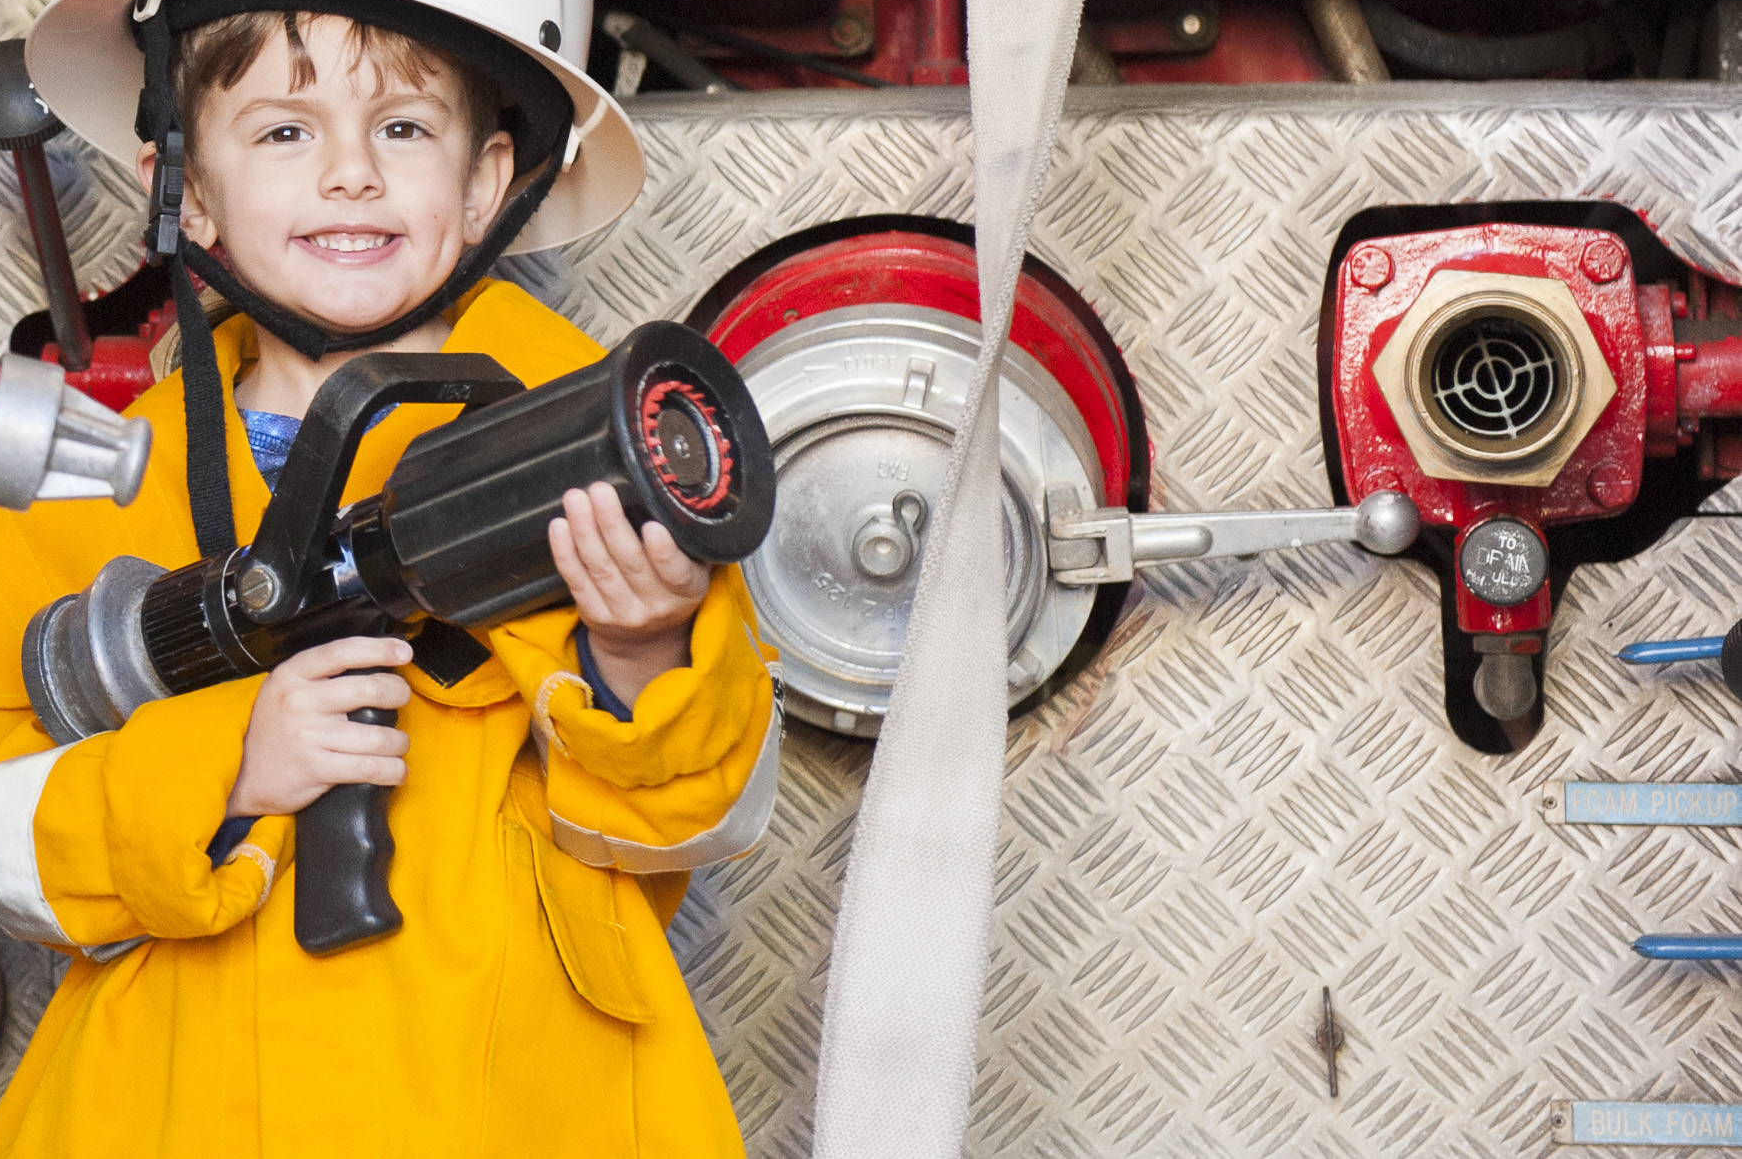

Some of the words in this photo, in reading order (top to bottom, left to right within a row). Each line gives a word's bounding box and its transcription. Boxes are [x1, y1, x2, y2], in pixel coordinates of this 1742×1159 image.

[1498, 534, 1518, 551] TO
[1571, 789, 1638, 817] FOAM
[1651, 790, 1739, 818] PICKUP
[1590, 1108, 1654, 1137] BULK
[1666, 1109, 1735, 1138] FOAM
